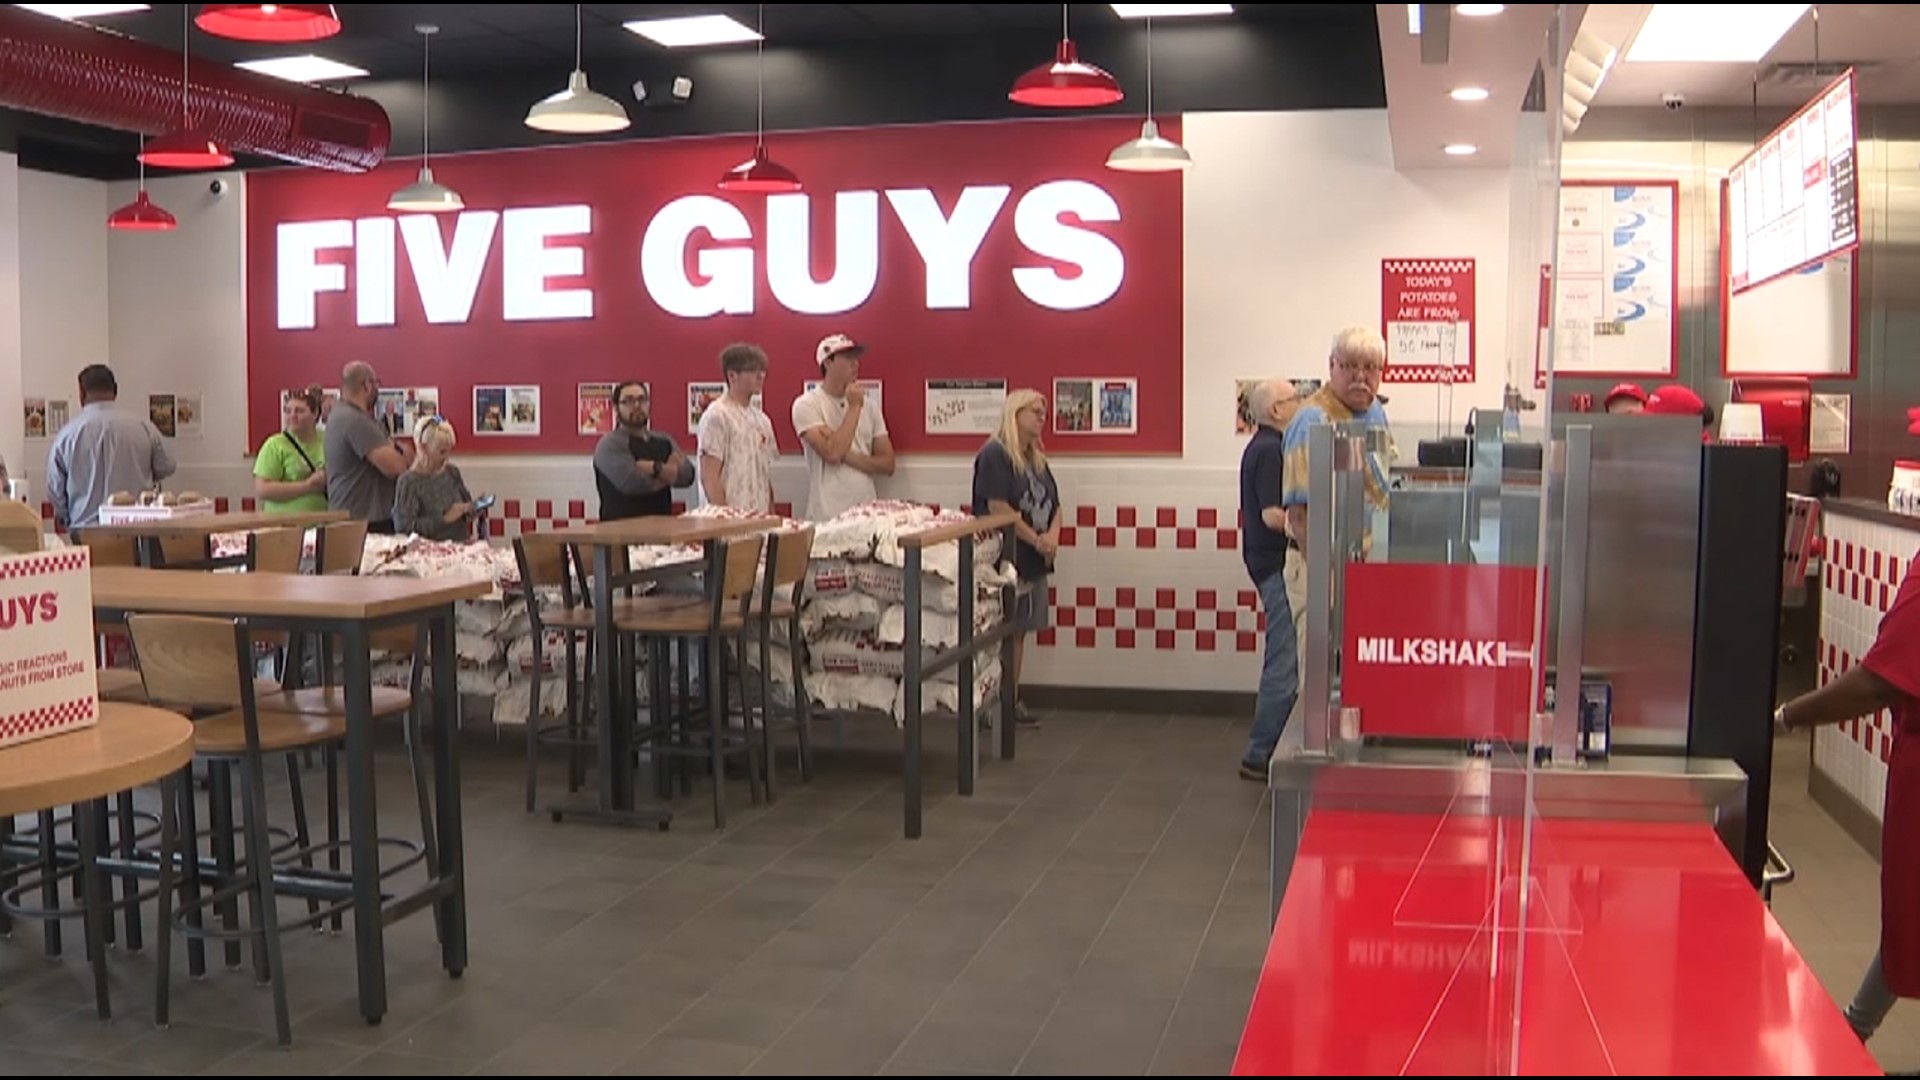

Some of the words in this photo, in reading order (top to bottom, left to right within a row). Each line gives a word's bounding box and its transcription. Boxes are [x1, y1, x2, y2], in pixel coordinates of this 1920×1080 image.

[276, 204, 595, 330] FIVE
[641, 179, 1126, 318] GUYS
[1400, 292, 1457, 303] POTATOES
[17, 650, 68, 672] REACTIONS
[29, 668, 55, 684] FROM
[57, 660, 84, 678] STORE
